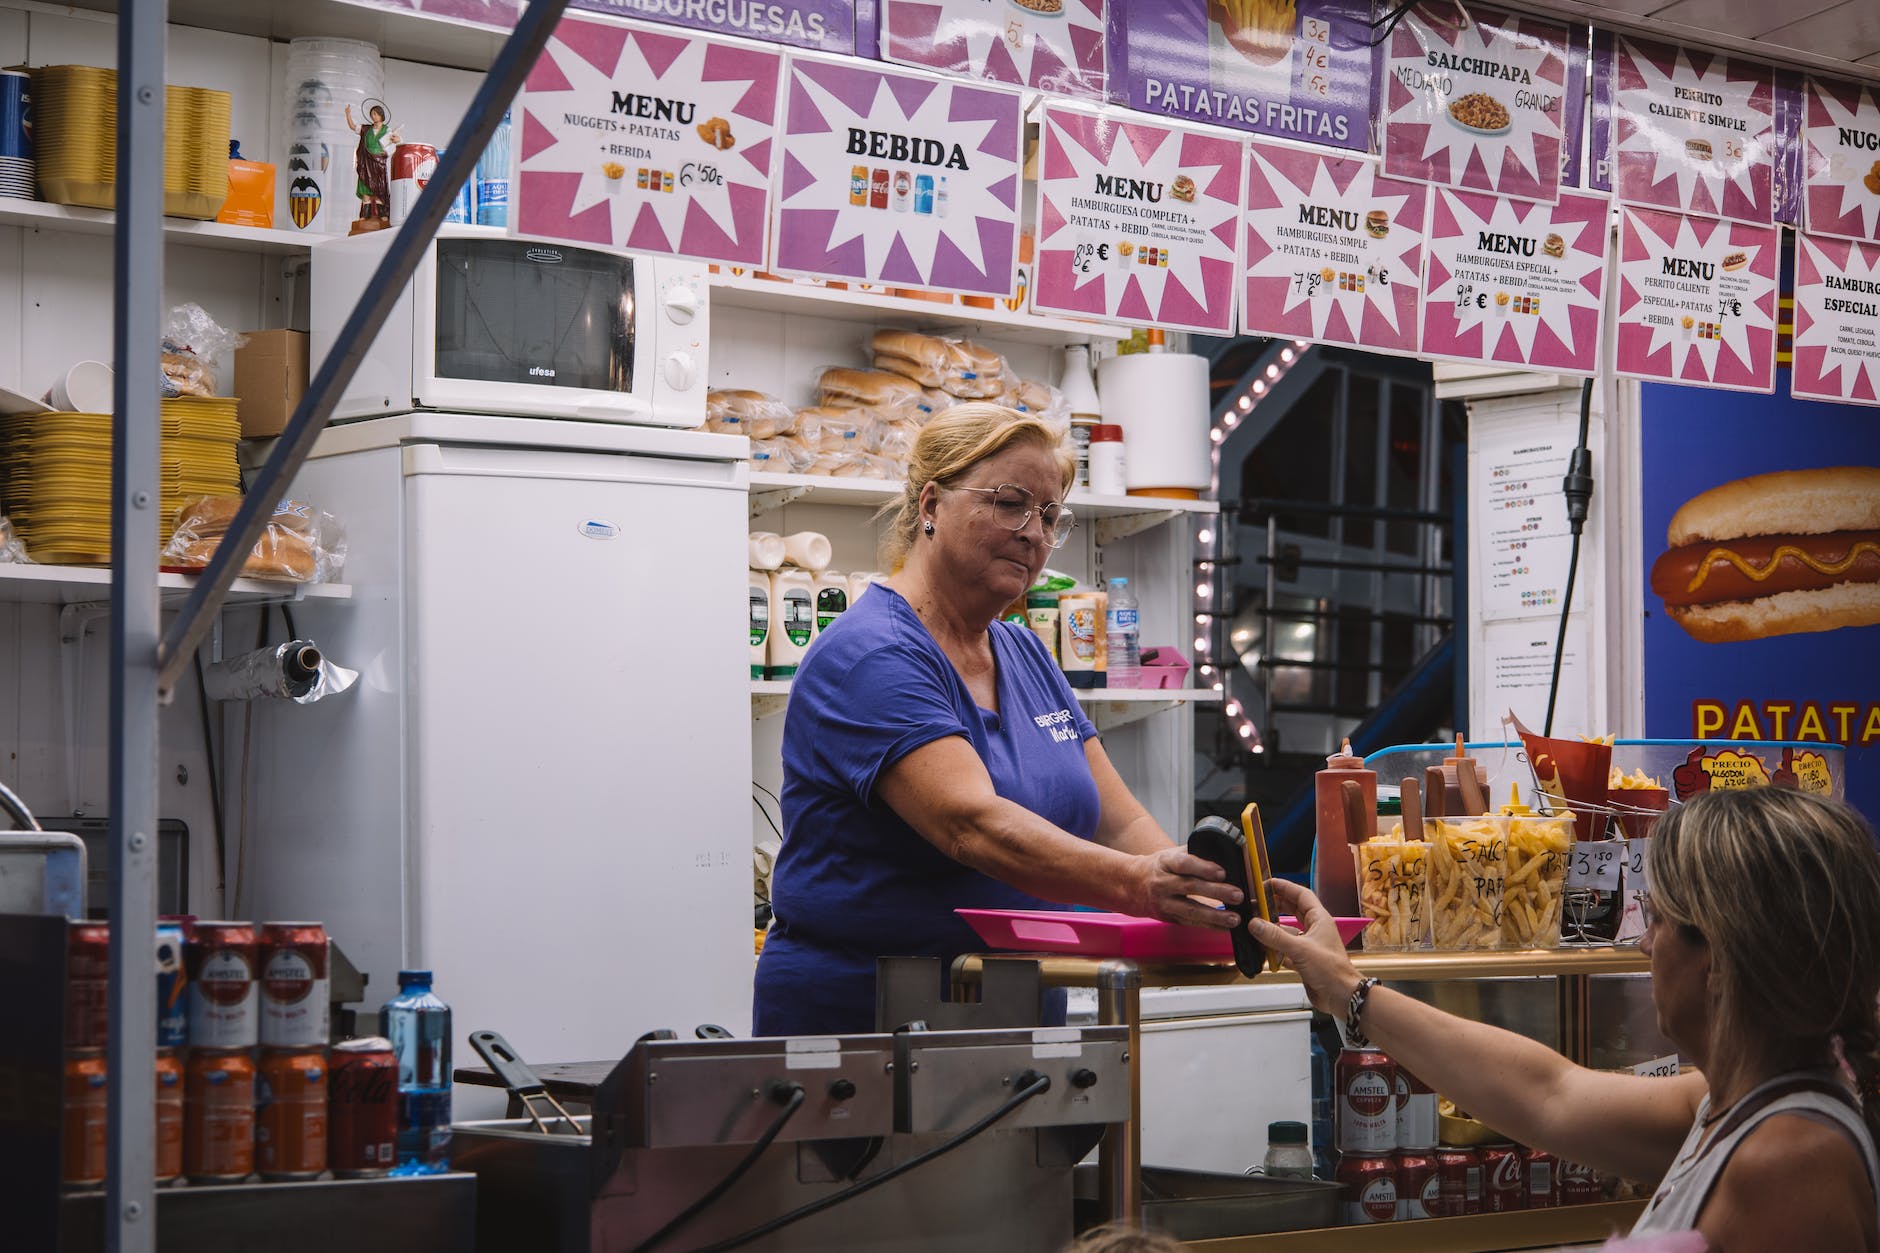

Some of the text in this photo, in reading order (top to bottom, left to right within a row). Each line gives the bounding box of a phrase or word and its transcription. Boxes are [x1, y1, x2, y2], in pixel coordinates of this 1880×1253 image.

[1427, 51, 1532, 85] SALCHIPAPA
[610, 91, 696, 125] MENU
[1515, 89, 1558, 112] GRANDE
[1674, 86, 1723, 107] PERRITO
[1146, 78, 1349, 141] PATATAS FRITAS
[1649, 102, 1746, 132] CALIENTE SIMPLE
[563, 113, 617, 132] NUGGETS
[629, 123, 681, 142] PATATAS
[846, 127, 969, 171] BEBIDA
[1838, 128, 1880, 151] NUG
[610, 144, 652, 160] BEBIDA
[1095, 173, 1163, 203] MENU
[1071, 197, 1138, 217] HAMBURGUESA
[1140, 207, 1188, 225] COMPLETA
[1299, 203, 1360, 232] MENU
[1070, 214, 1110, 230] PATATAS
[1121, 222, 1150, 236] BEBID
[1277, 226, 1368, 250] HAMBURGUESA SIMPLE
[1477, 231, 1537, 257] MENU
[1283, 245, 1321, 259] PATATAS
[1330, 251, 1360, 265] BEBIDA
[1456, 253, 1514, 271] HAMBURGUESA
[1515, 261, 1552, 276] ESPECIAL
[1454, 269, 1490, 283] PATATAS
[1499, 275, 1528, 288] BEBIDA
[1662, 256, 1715, 281] MENU
[1644, 277, 1710, 295] PERRITO CALIENTE
[1680, 300, 1713, 314] PATATAS
[1824, 297, 1879, 317] ESPECIAL
[1648, 314, 1674, 327] BEBIDA
[529, 366, 556, 377] ufesa
[1697, 704, 1880, 742] PATATA
[1712, 760, 1751, 768] PRECIO
[1353, 1086, 1385, 1095] AMSTEL
